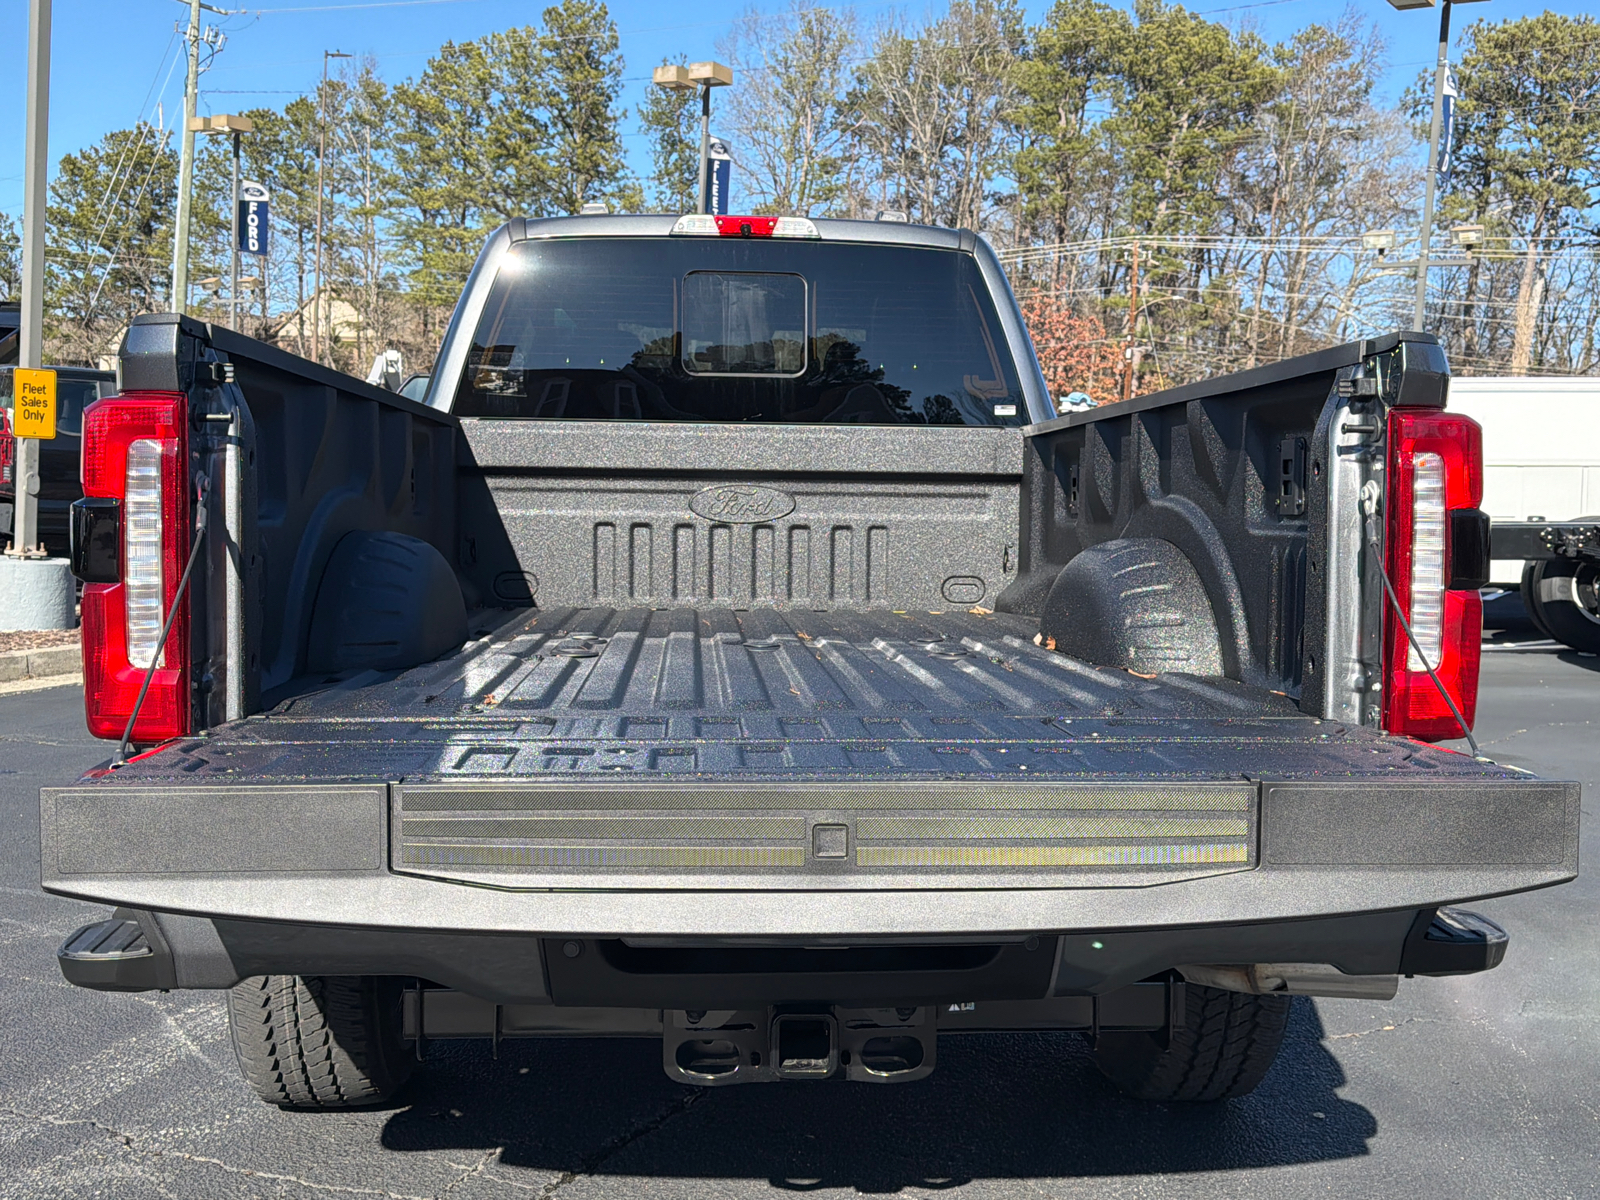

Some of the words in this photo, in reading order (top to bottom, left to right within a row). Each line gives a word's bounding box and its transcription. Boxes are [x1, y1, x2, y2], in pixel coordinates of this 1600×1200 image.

[712, 160, 720, 215] FLEET
[247, 202, 259, 251] FORD
[23, 383, 47, 395] Fleet
[21, 396, 48, 408] Sales
[23, 409, 46, 424] Only
[708, 488, 775, 516] Ford
